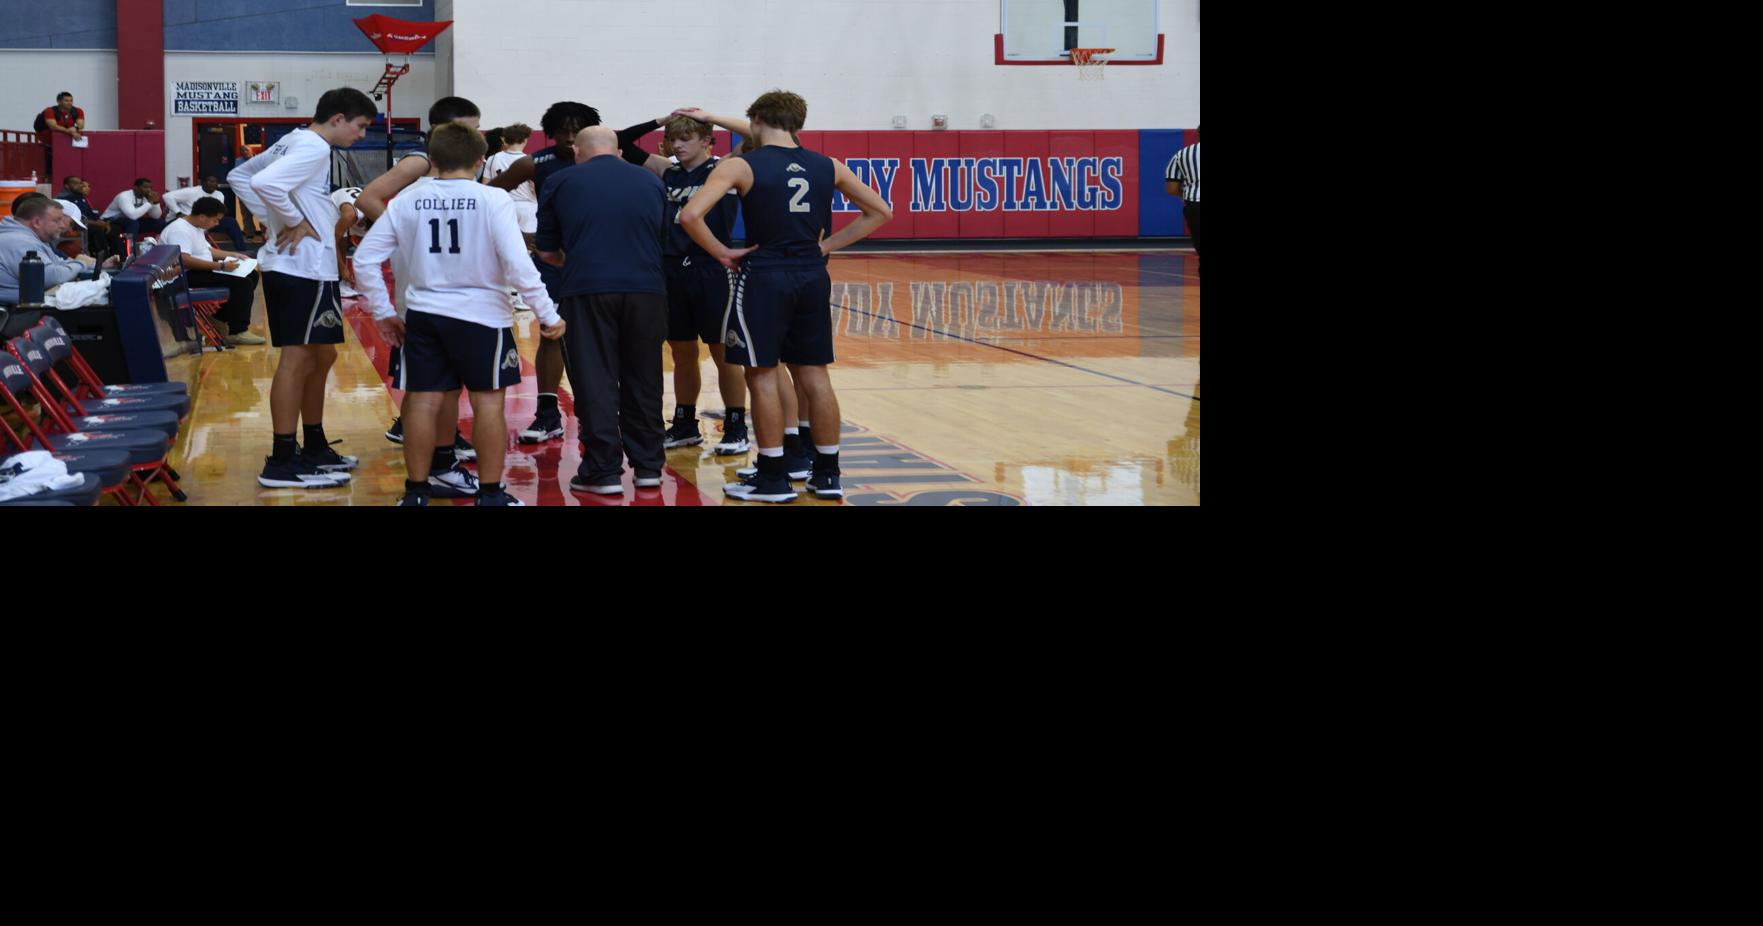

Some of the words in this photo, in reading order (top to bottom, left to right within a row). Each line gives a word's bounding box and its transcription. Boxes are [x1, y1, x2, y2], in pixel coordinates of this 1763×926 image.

[176, 82, 237, 91] MADISONVILLE
[256, 90, 272, 100] EXIT
[177, 101, 236, 112] BASKETBALL
[910, 157, 1122, 212] MUSTANGS
[787, 177, 811, 212] 2
[415, 198, 476, 210] COLLIER
[428, 218, 461, 254] 11
